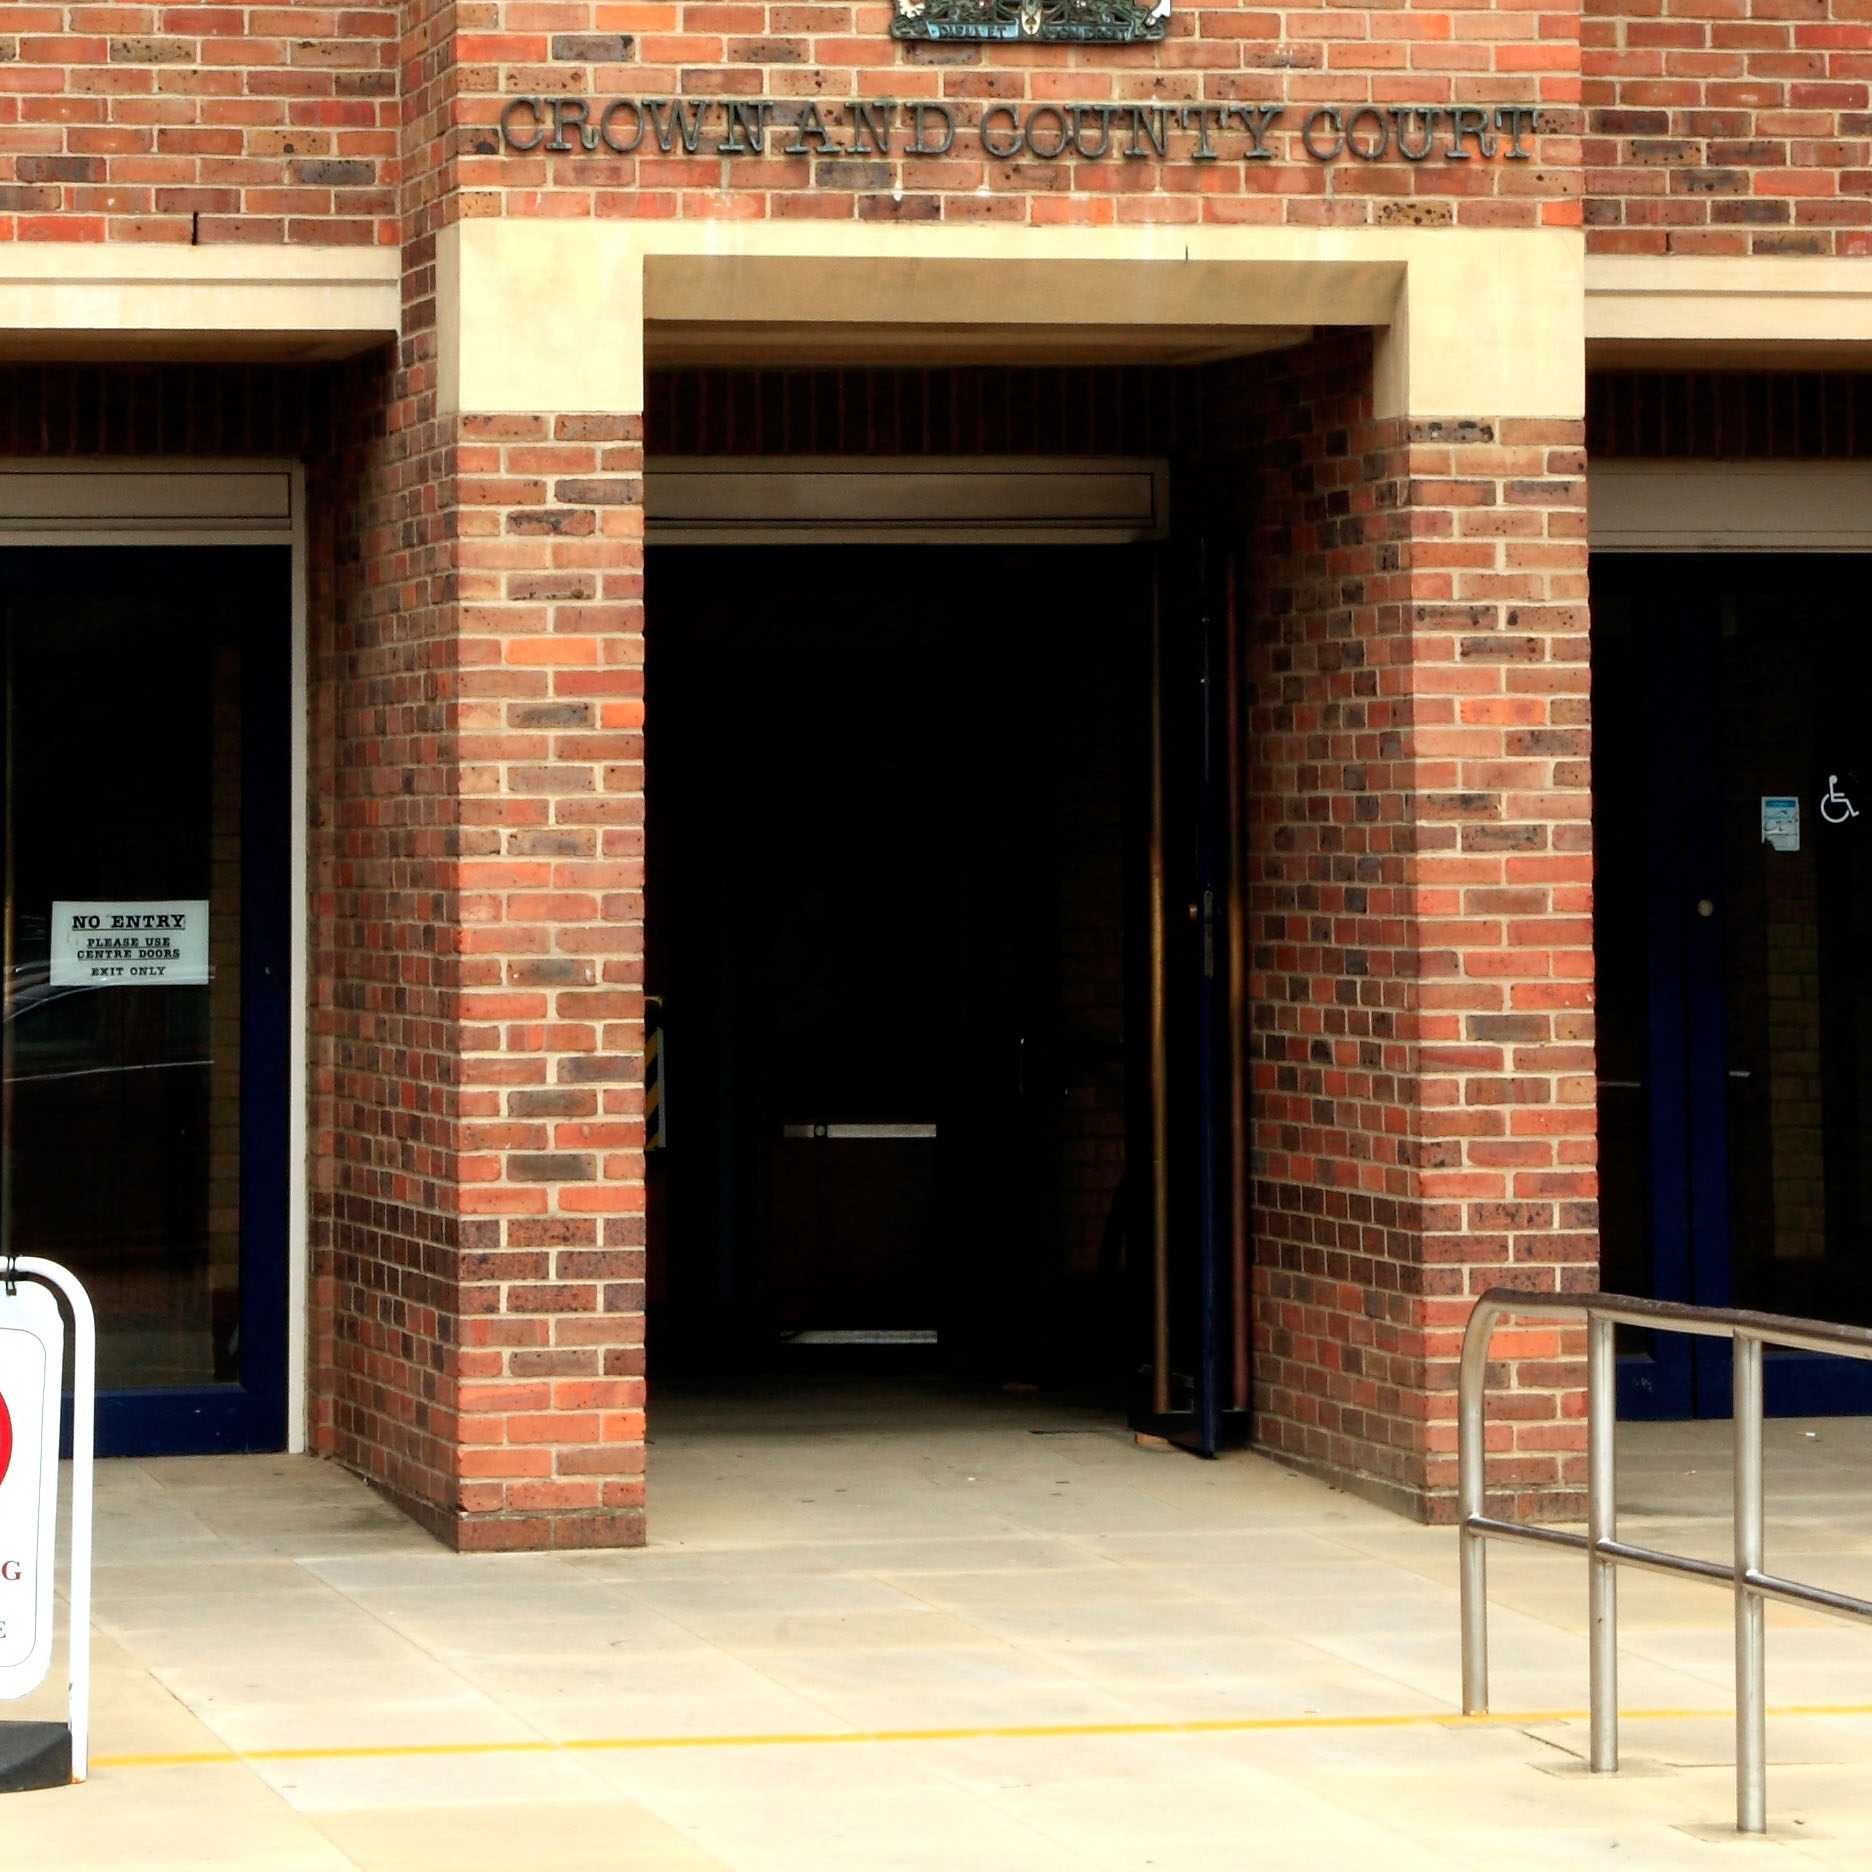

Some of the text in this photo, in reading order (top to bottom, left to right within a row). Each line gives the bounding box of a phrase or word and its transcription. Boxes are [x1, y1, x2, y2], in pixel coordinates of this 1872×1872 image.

[500, 96, 1538, 160] CROWN AND COUNTY COURT
[72, 914, 185, 929] NO ENTRY
[87, 937, 171, 948] PLEASE USE
[77, 948, 180, 960] CENTRE DOORS
[91, 966, 166, 976] EXIT ONLY
